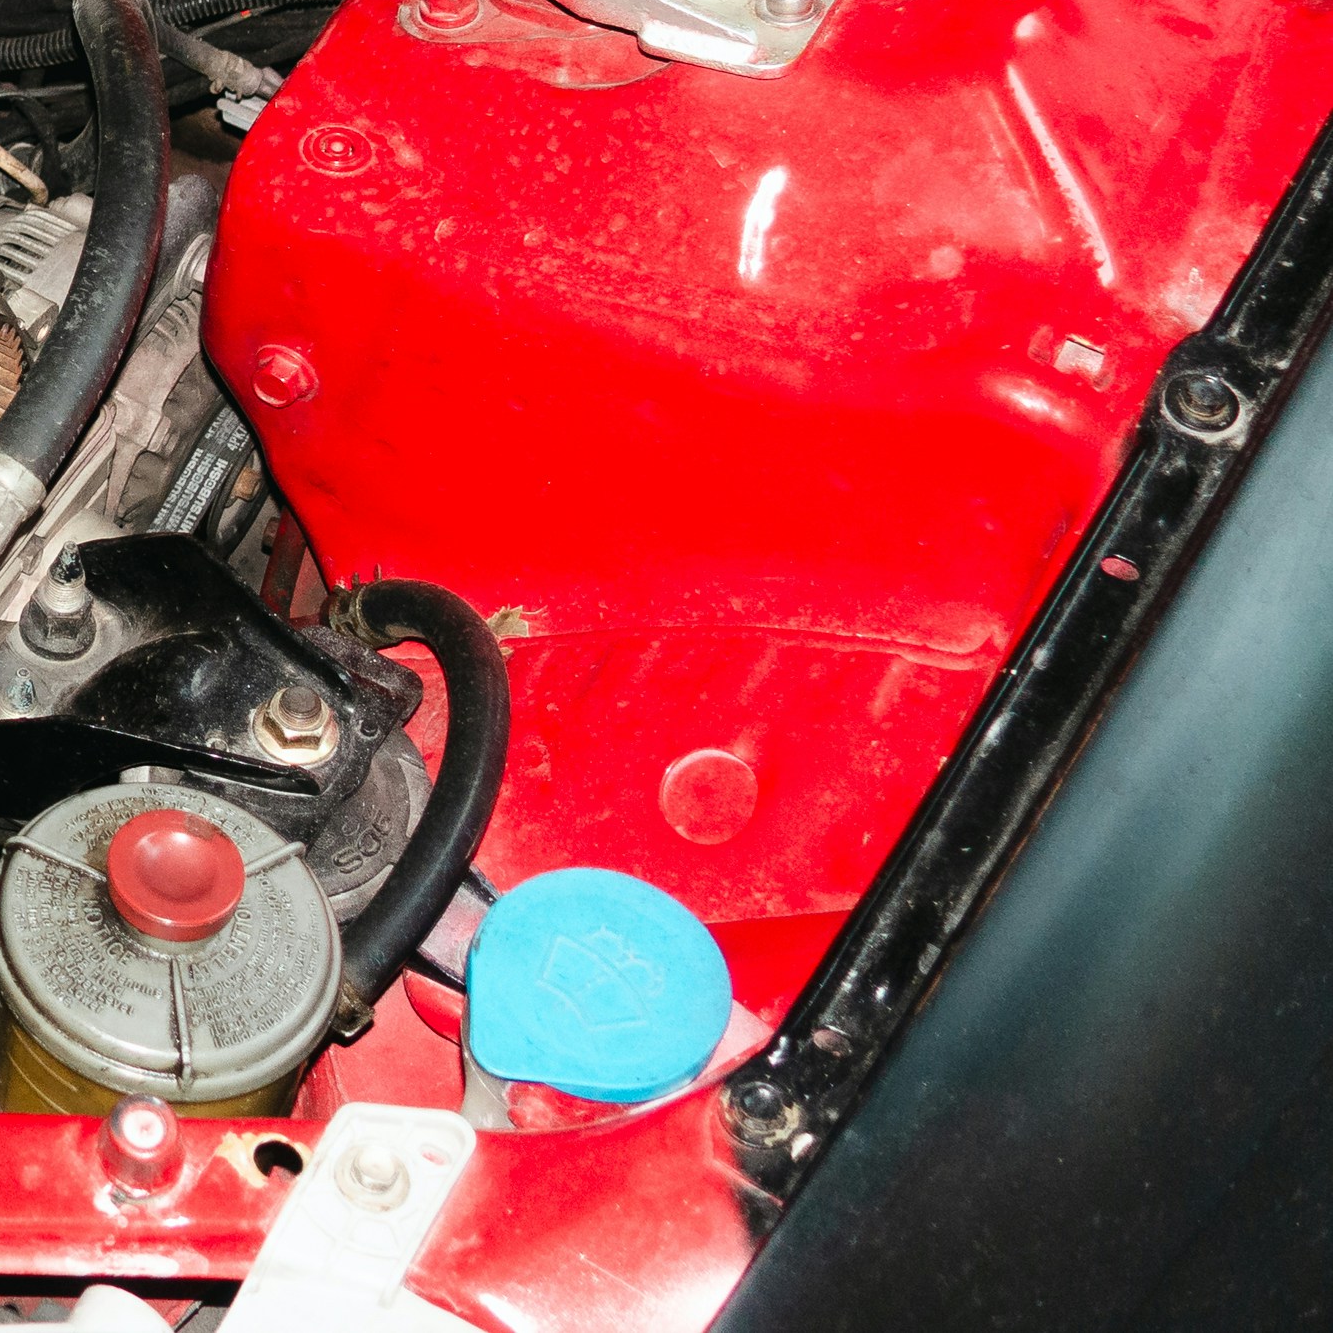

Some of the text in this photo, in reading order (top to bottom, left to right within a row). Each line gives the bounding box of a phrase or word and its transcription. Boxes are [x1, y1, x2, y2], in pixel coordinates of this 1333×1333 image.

[164, 451, 218, 531] MITSUBOSHI
[177, 457, 229, 534] MITSUBOSHI
[51, 874, 67, 911] Power
[75, 931, 108, 971] HONDA
[83, 898, 137, 967] NOTICE
[66, 962, 97, 993] Upper
[96, 987, 136, 1016] Level
[66, 982, 105, 1015] Lower
